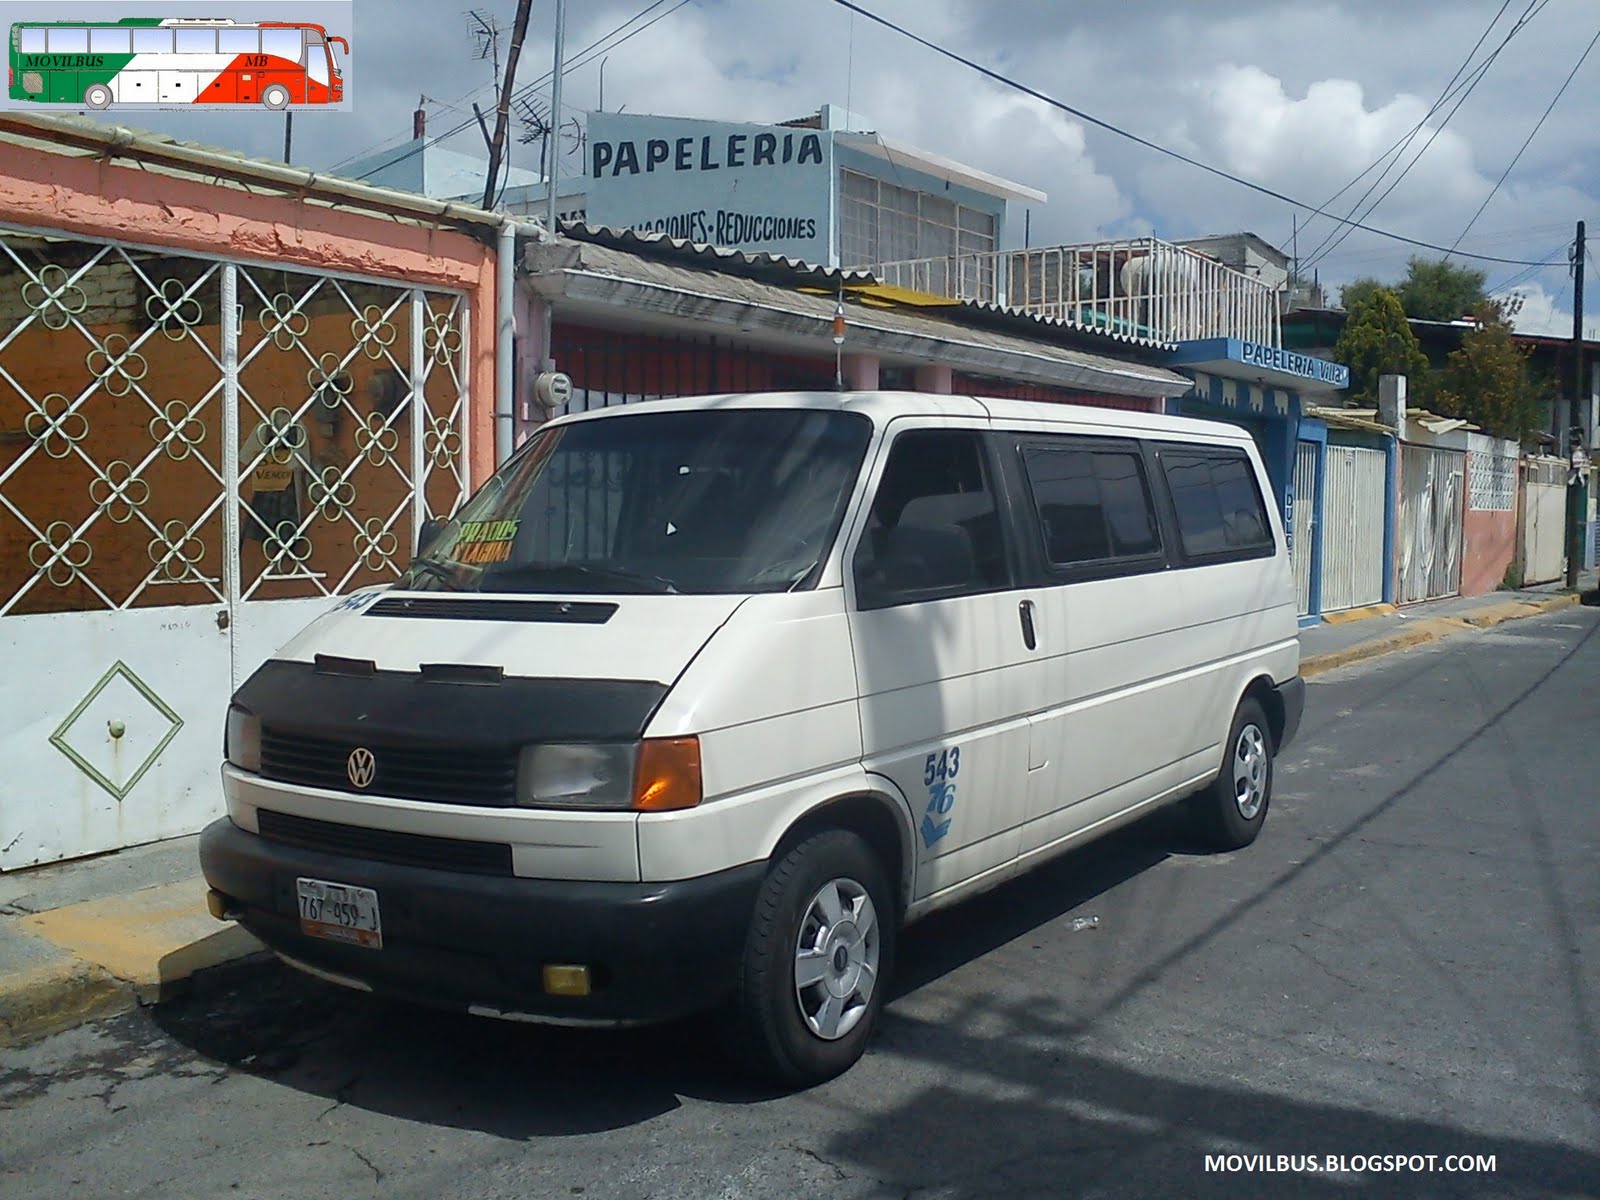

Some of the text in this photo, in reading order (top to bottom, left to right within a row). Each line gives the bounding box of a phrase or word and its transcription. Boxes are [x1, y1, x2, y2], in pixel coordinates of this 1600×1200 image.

[593, 133, 823, 178] PAPELERIA
[716, 210, 816, 245] REDUCCIONES
[1242, 343, 1314, 376] PAPELERIA
[924, 746, 960, 787] 543
